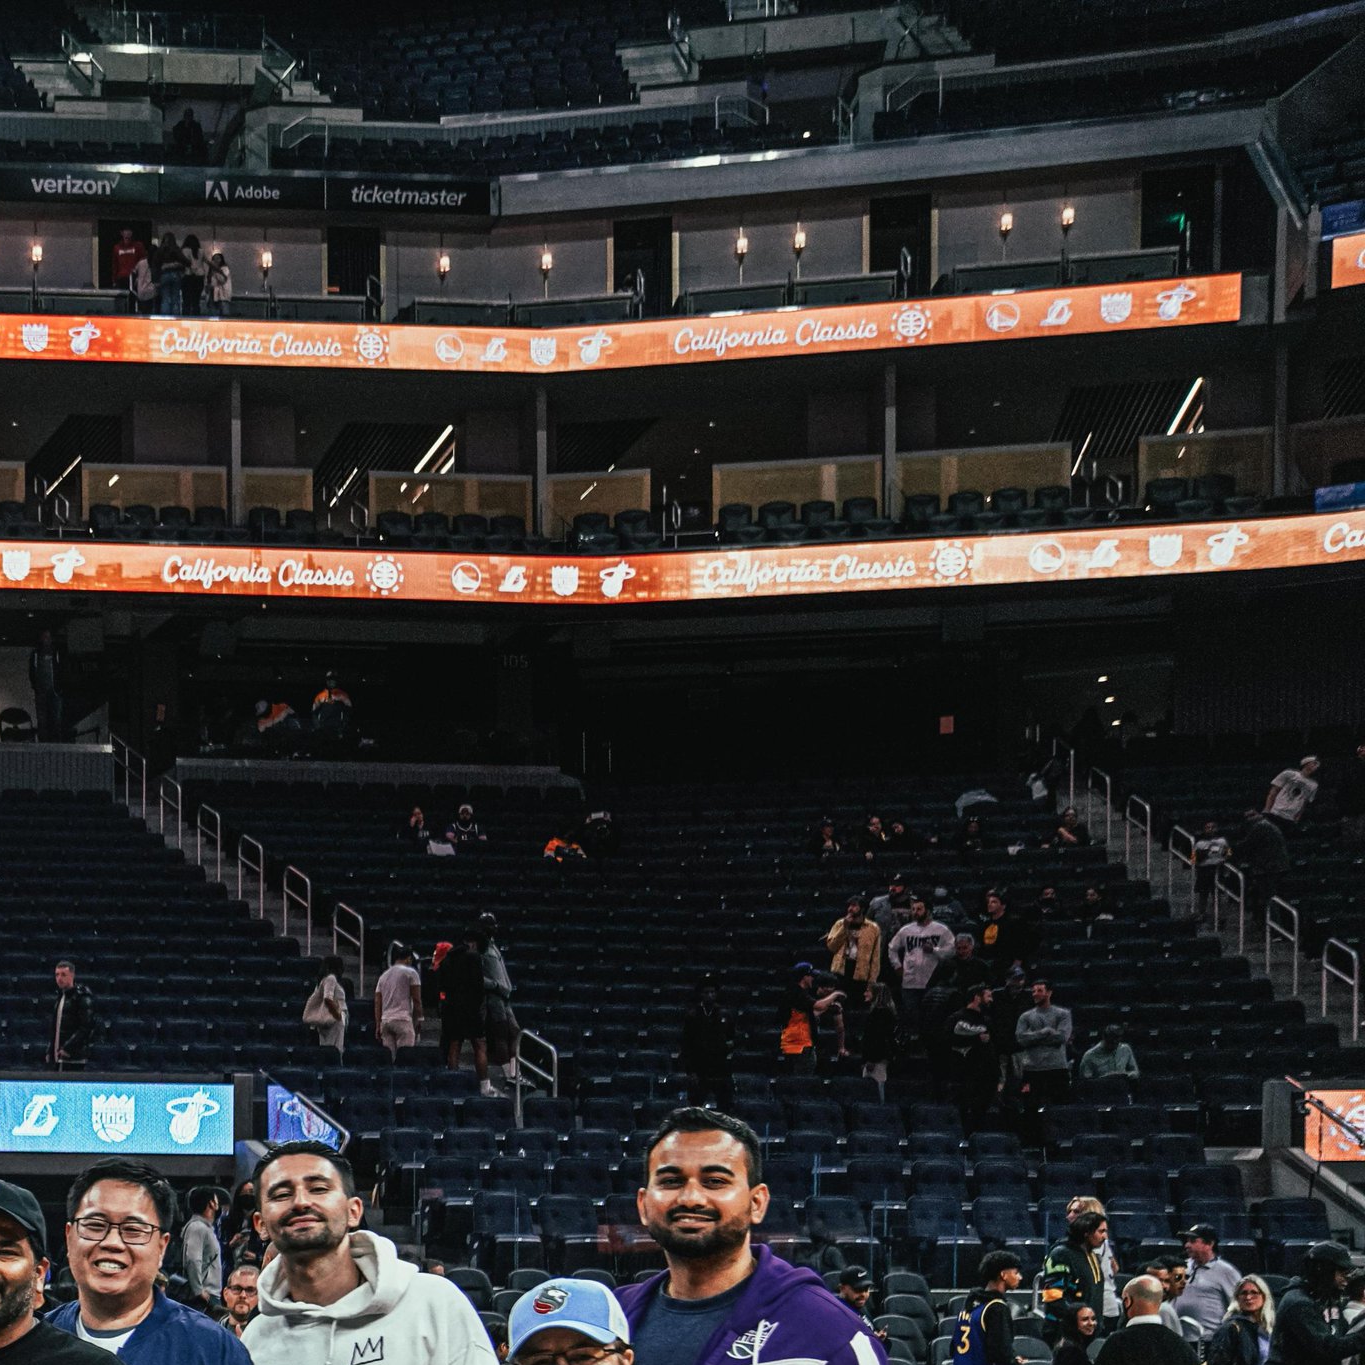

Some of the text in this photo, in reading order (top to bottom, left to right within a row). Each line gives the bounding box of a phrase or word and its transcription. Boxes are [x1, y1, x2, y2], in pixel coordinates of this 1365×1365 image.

[31, 175, 113, 195] verizon
[234, 186, 280, 200] Adobe
[351, 185, 468, 206] ticketmaster
[159, 328, 343, 359] California Classic
[673, 317, 878, 357] California Classic
[162, 555, 355, 589] California Classic
[703, 553, 916, 593] California Classic
[957, 1325, 971, 1355] 3
